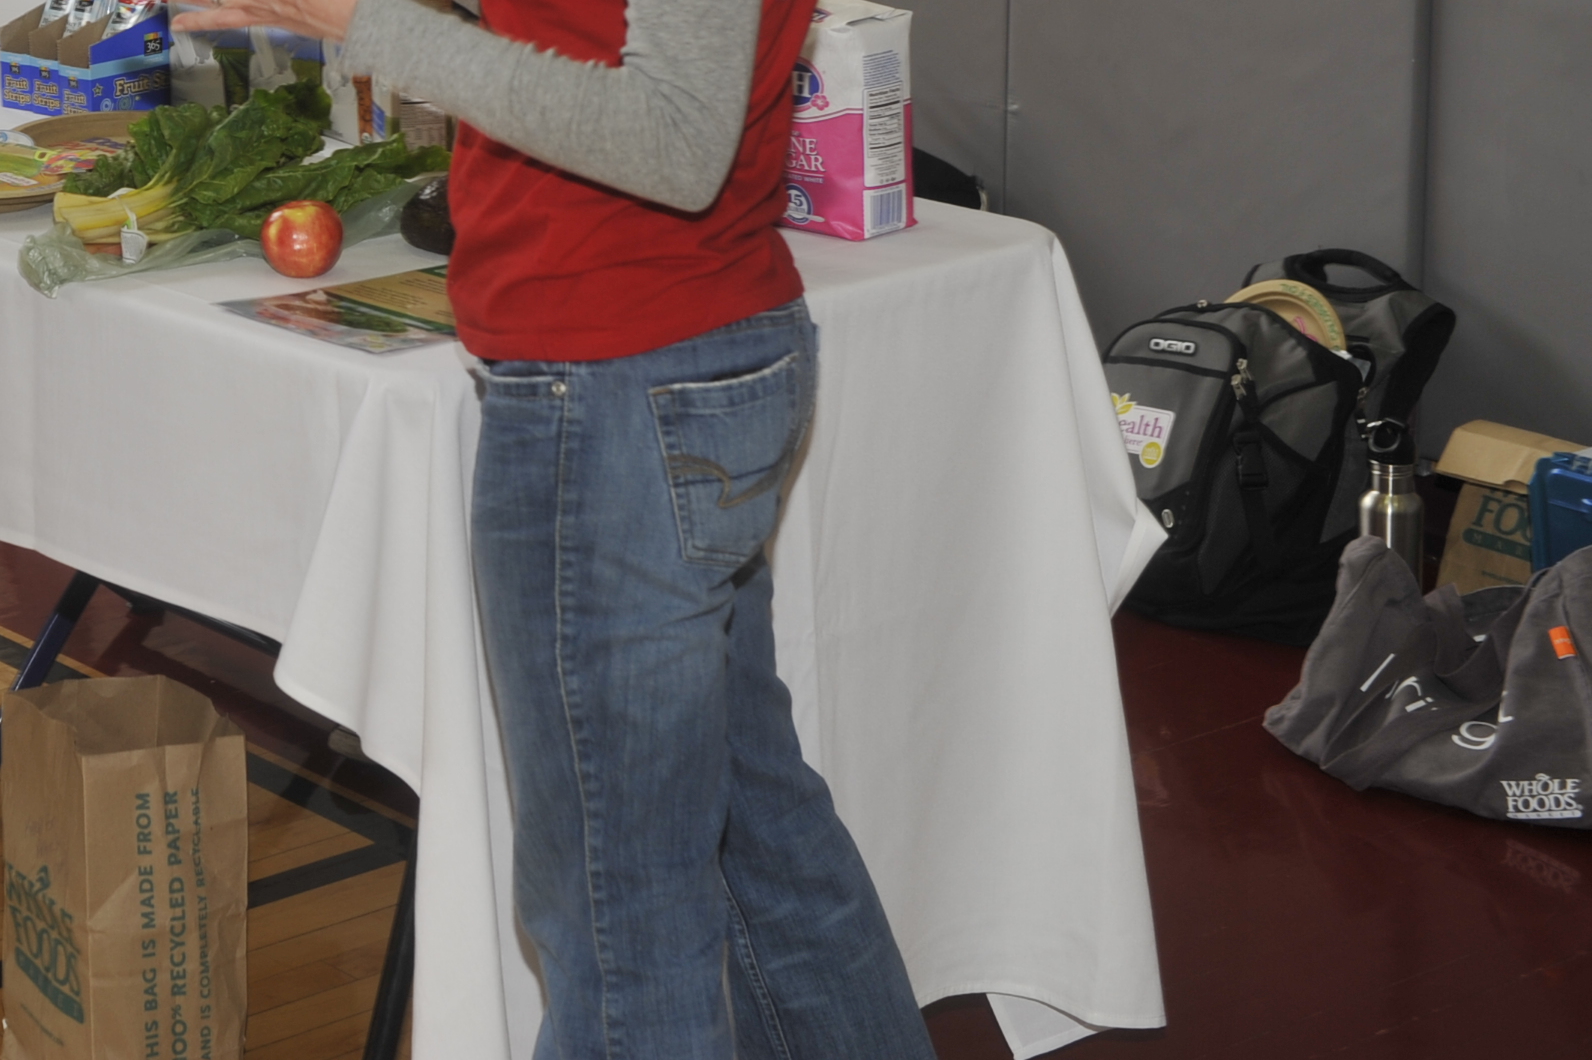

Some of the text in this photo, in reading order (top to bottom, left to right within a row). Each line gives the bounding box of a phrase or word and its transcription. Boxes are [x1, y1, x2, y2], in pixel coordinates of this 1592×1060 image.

[146, 40, 161, 53] 365
[4, 75, 28, 90] Fruit
[34, 80, 58, 95] Fruit
[114, 77, 150, 97] Fruit
[4, 89, 31, 105] Strips
[33, 94, 60, 110] Strips
[63, 90, 87, 104] Fruit
[789, 137, 818, 155] NE
[785, 152, 826, 172] GAR
[1149, 338, 1196, 354] OGIO
[1118, 415, 1164, 440] ealth
[1499, 773, 1582, 796] WHOLE
[1506, 793, 1578, 813] FOODS
[135, 792, 153, 856] FROM
[164, 790, 182, 866] PAPER
[138, 865, 156, 930] MADE
[190, 786, 212, 1060] AND IS COMPLETELY RECYCLABLE
[169, 876, 187, 997] RECYCLED
[142, 938, 157, 958] IS
[143, 967, 159, 1012] BAG
